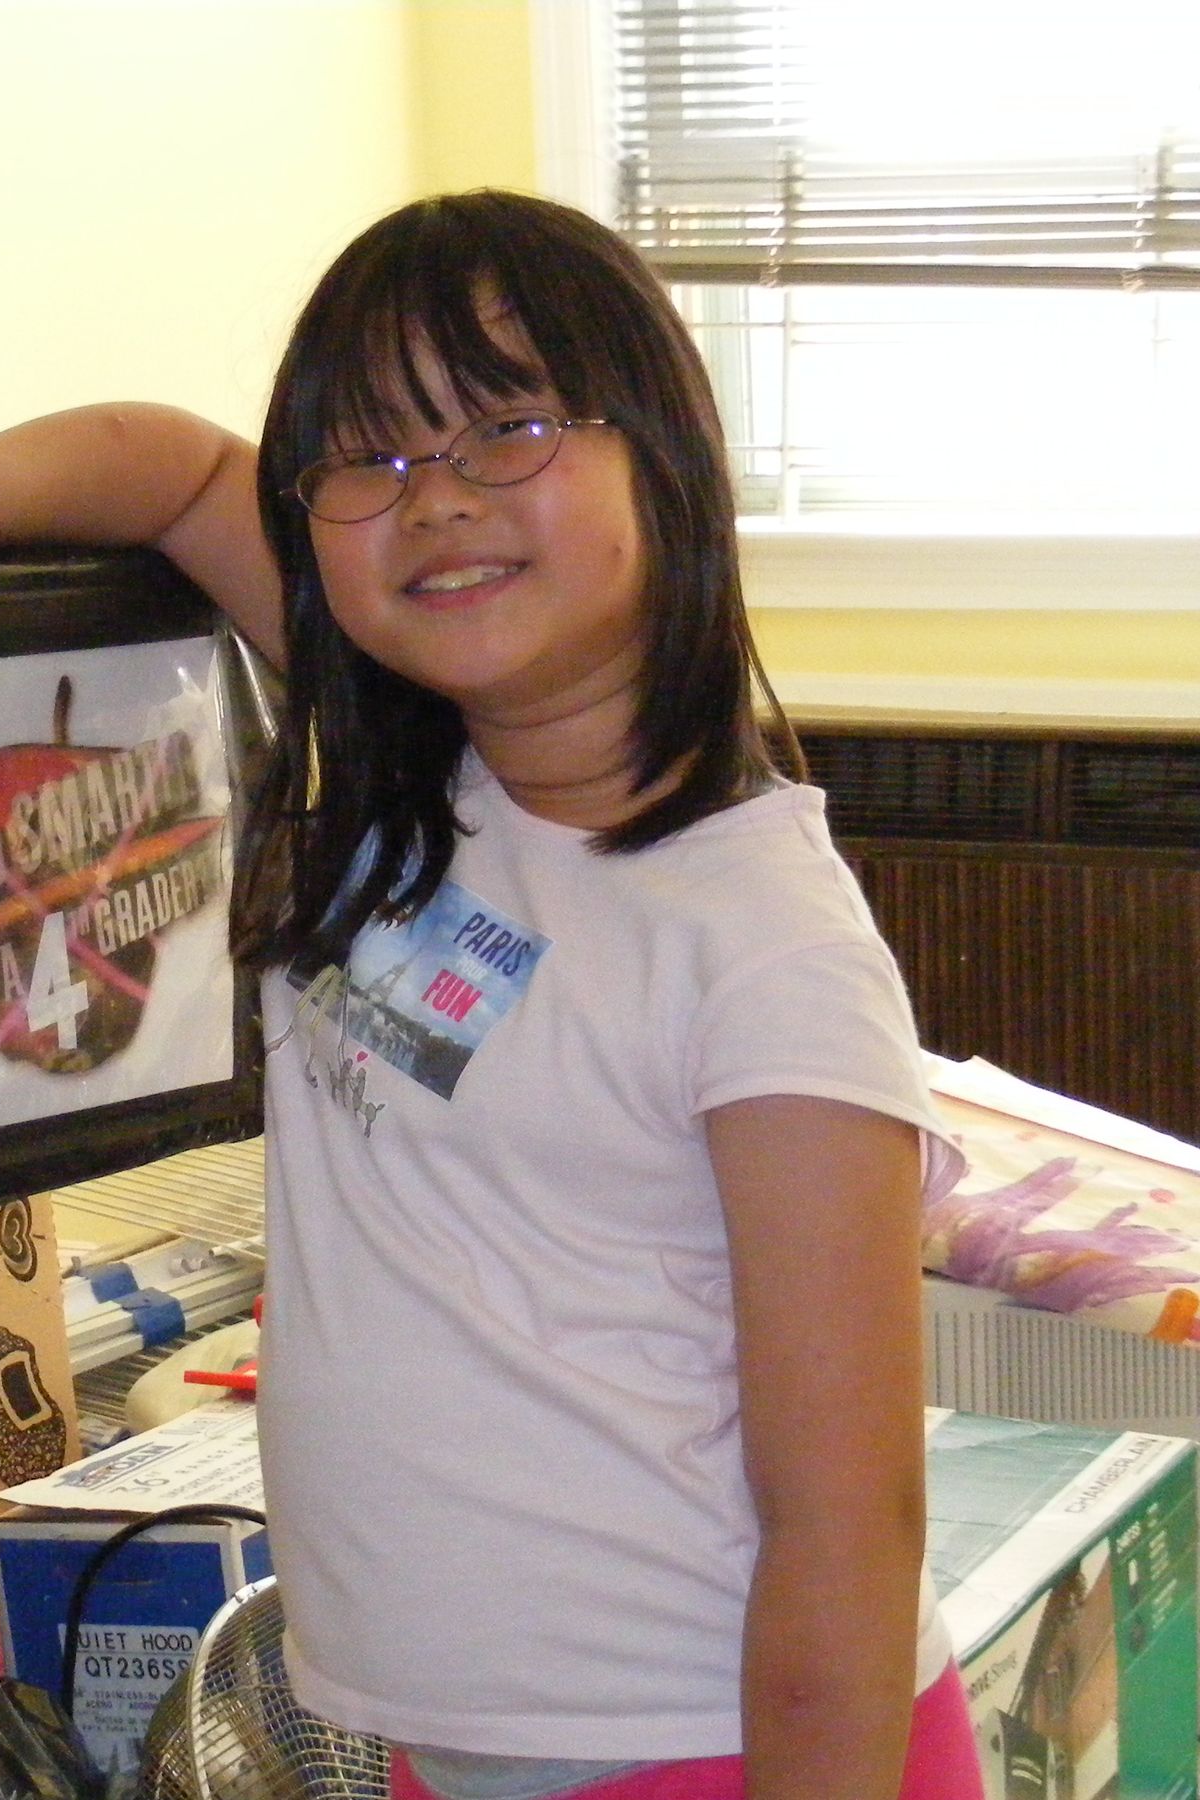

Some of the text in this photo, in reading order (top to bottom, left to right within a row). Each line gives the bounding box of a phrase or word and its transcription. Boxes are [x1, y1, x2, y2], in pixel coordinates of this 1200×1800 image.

[0, 942, 25, 1001] A
[453, 911, 531, 976] PARIS
[420, 968, 483, 1023] FUN
[77, 1631, 194, 1651] UIET HOOD
